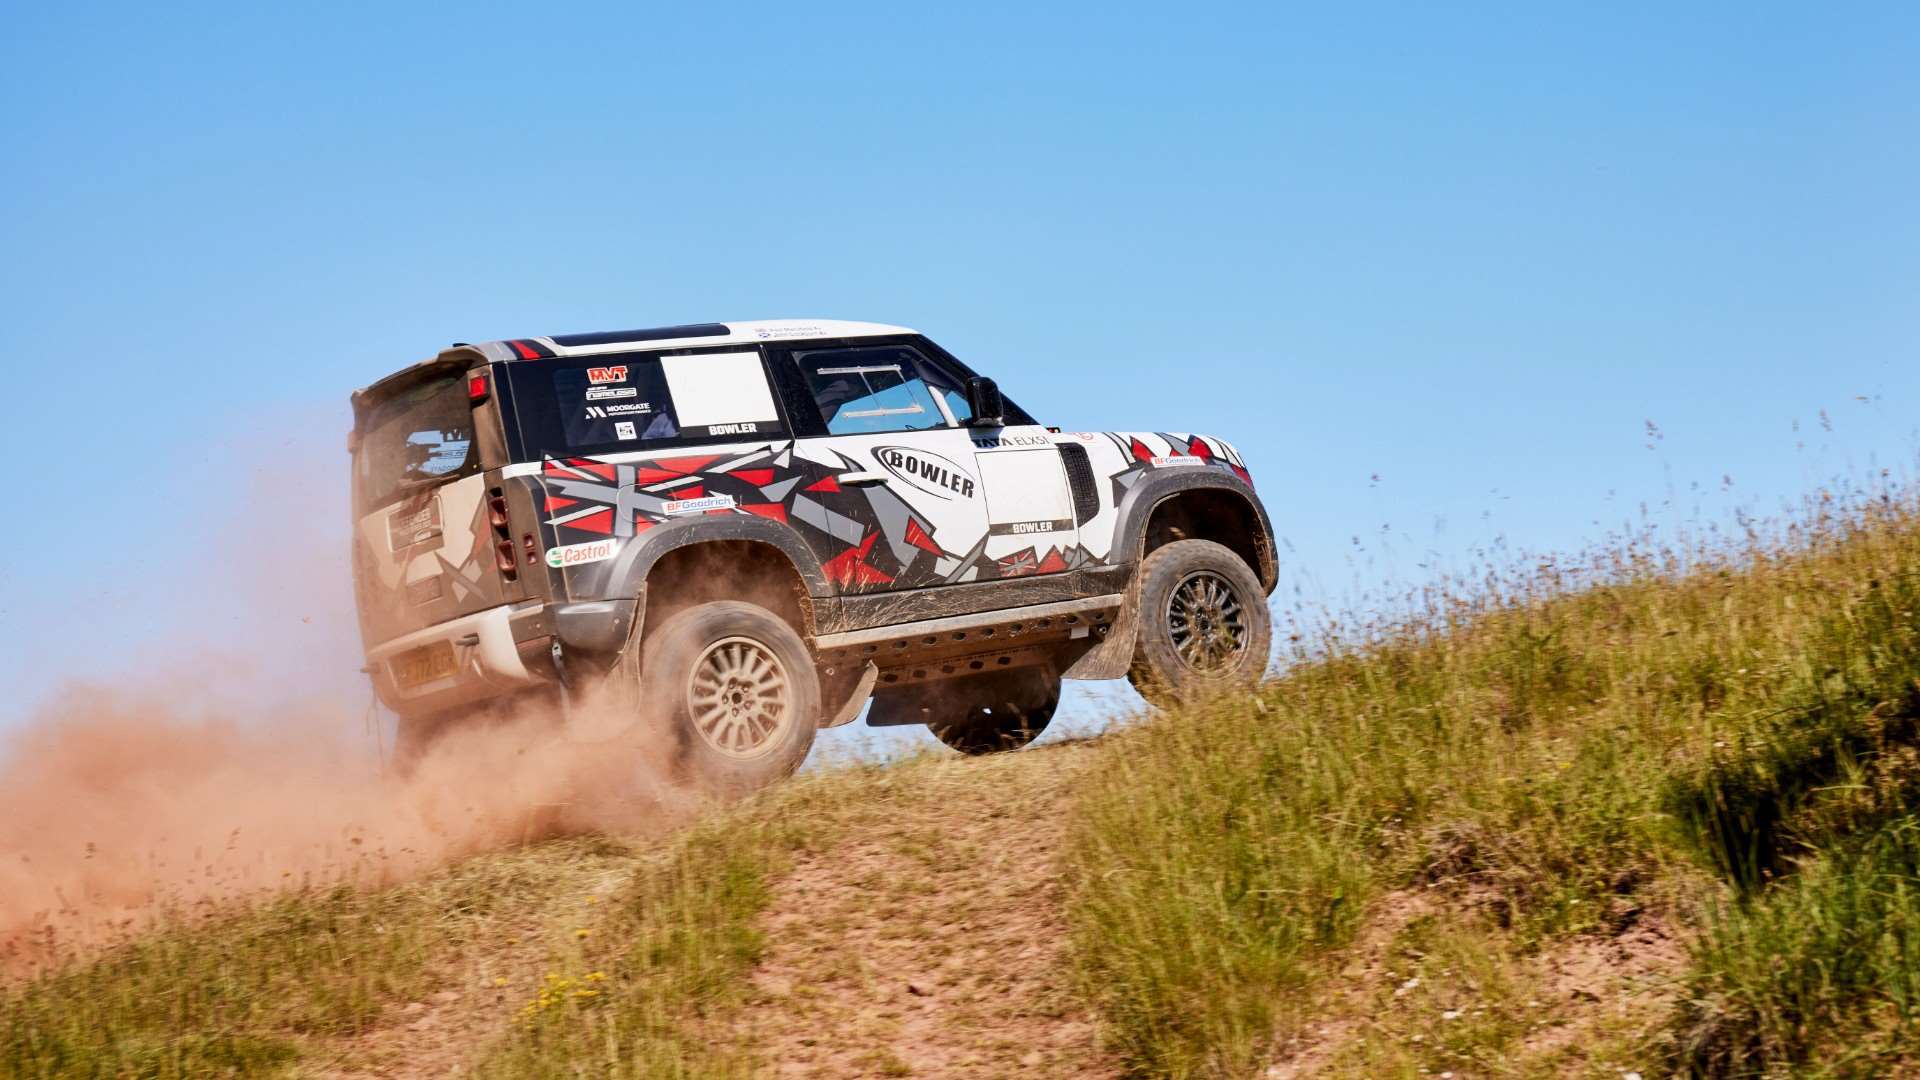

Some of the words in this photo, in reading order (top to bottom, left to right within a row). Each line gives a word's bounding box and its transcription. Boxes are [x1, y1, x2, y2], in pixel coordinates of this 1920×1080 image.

[606, 402, 651, 412] MOORGATE
[708, 423, 757, 436] BOWLER
[973, 438, 1013, 448] TATA
[1014, 436, 1050, 446] ELXSI
[890, 451, 975, 498] BOWLER
[667, 497, 732, 512] BFGoodrich
[1012, 521, 1053, 534] BOWLER
[564, 544, 611, 563] Castrol
